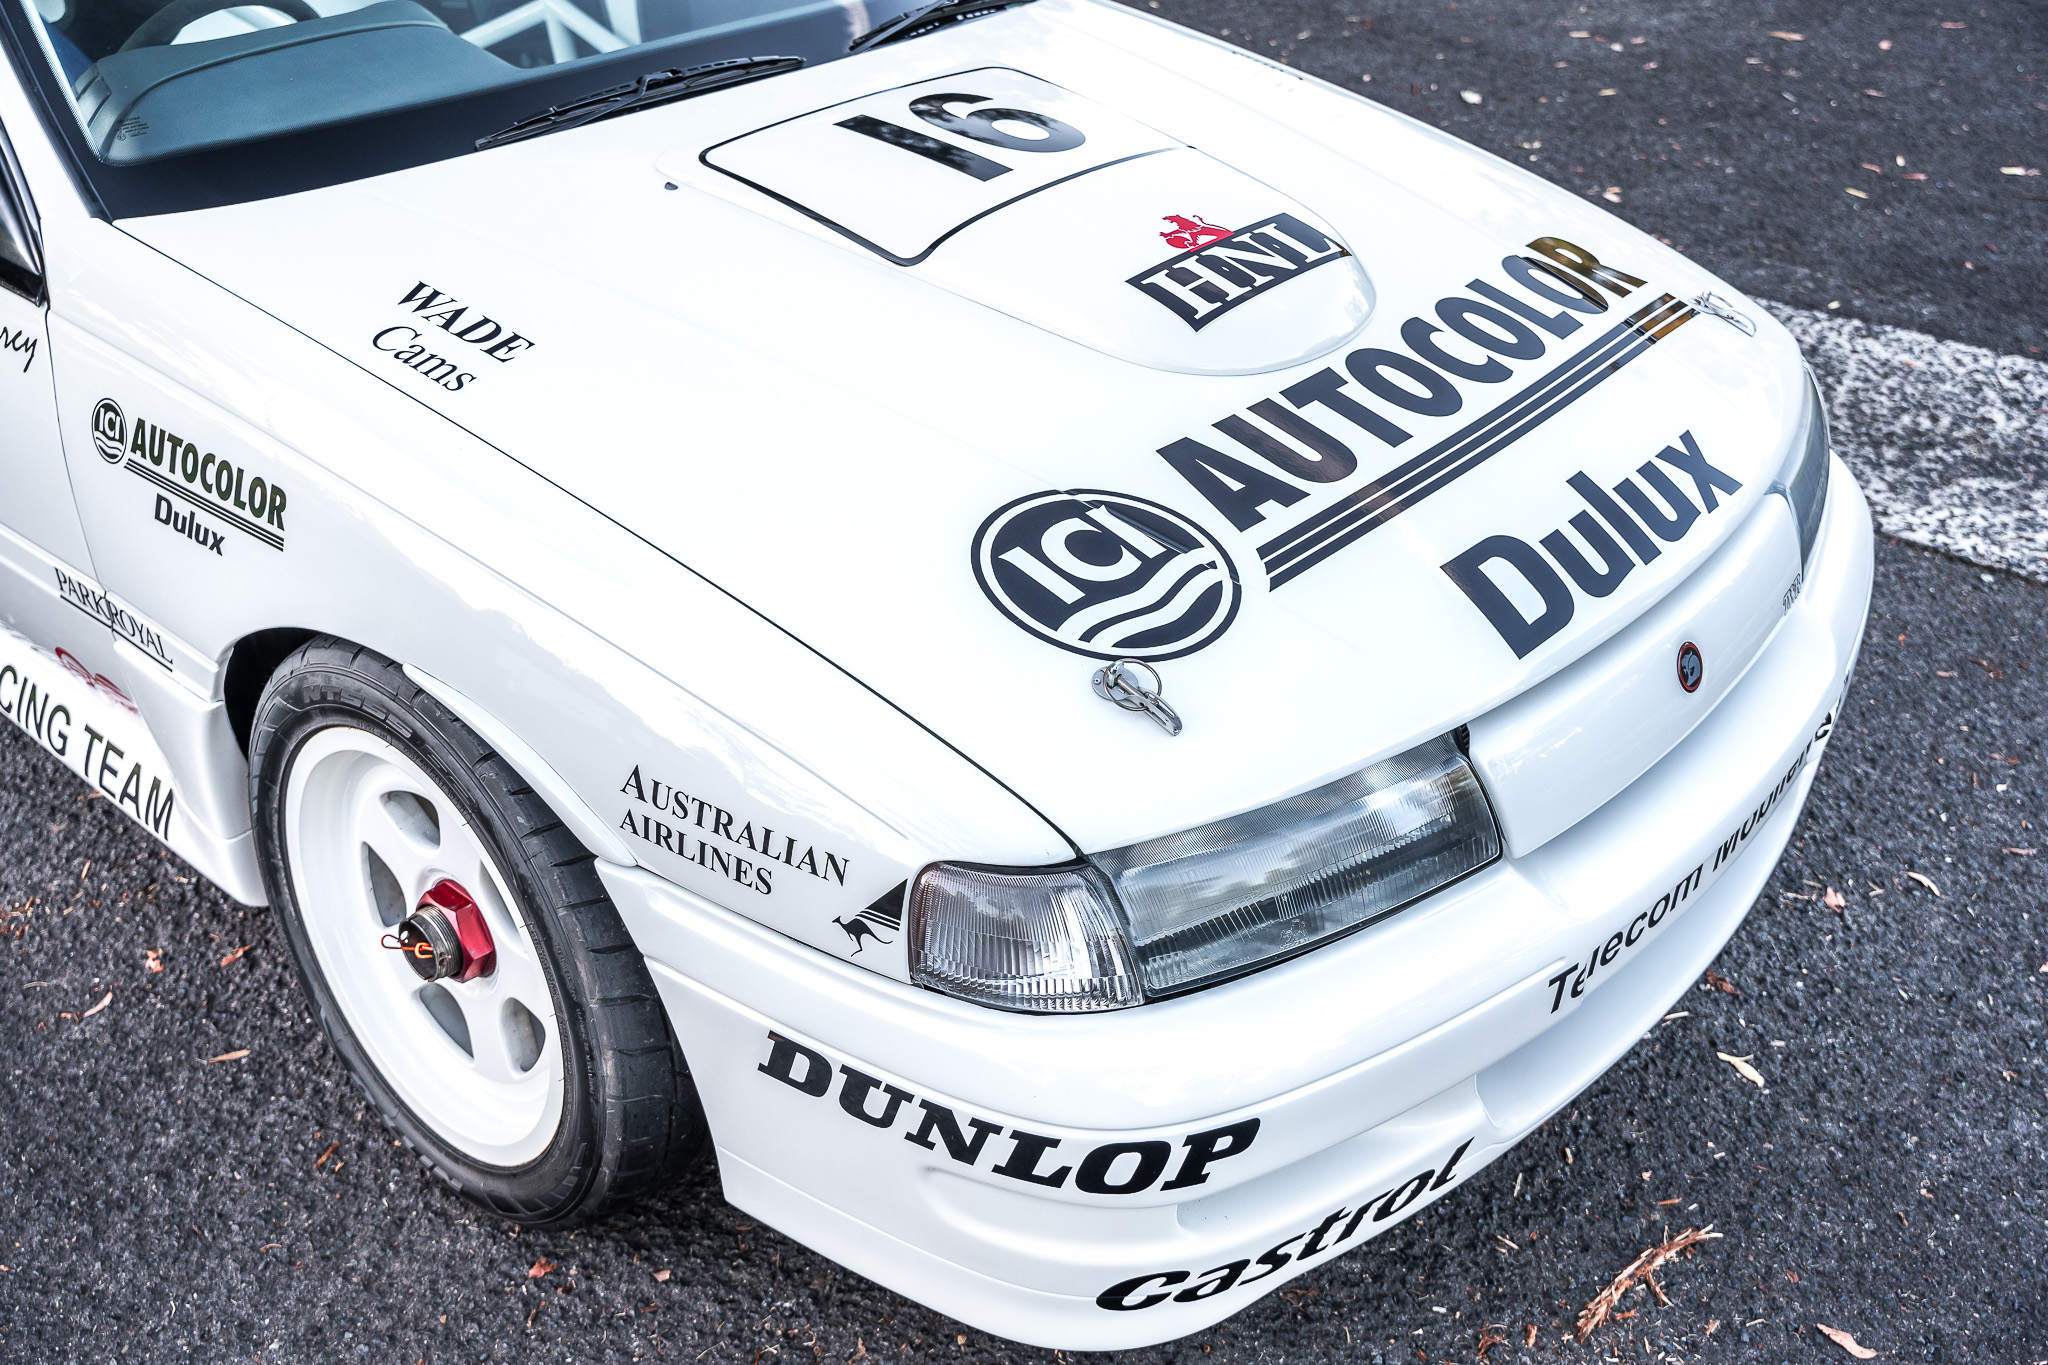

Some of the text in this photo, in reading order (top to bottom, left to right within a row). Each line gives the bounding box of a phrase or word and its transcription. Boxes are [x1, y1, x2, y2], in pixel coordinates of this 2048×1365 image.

[833, 93, 1086, 182] 16
[397, 281, 535, 364] WADE
[1141, 222, 1343, 320] HNL
[372, 326, 477, 392] Cams
[1155, 236, 1648, 533] AUTOCOLOR
[98, 406, 123, 436] ICI
[131, 417, 287, 532] AUTOCOLOR
[154, 493, 226, 557] Dulux
[998, 504, 1168, 605] ICI
[1440, 429, 1743, 660] Dulux
[84, 723, 175, 841] TEAM
[620, 764, 850, 887] AUSTRALIAN
[619, 809, 773, 895] AIRLINES
[1548, 863, 1704, 1015] Telecom
[757, 1030, 1261, 1195] DUNLOP
[1095, 1136, 1475, 1312] Castrol
